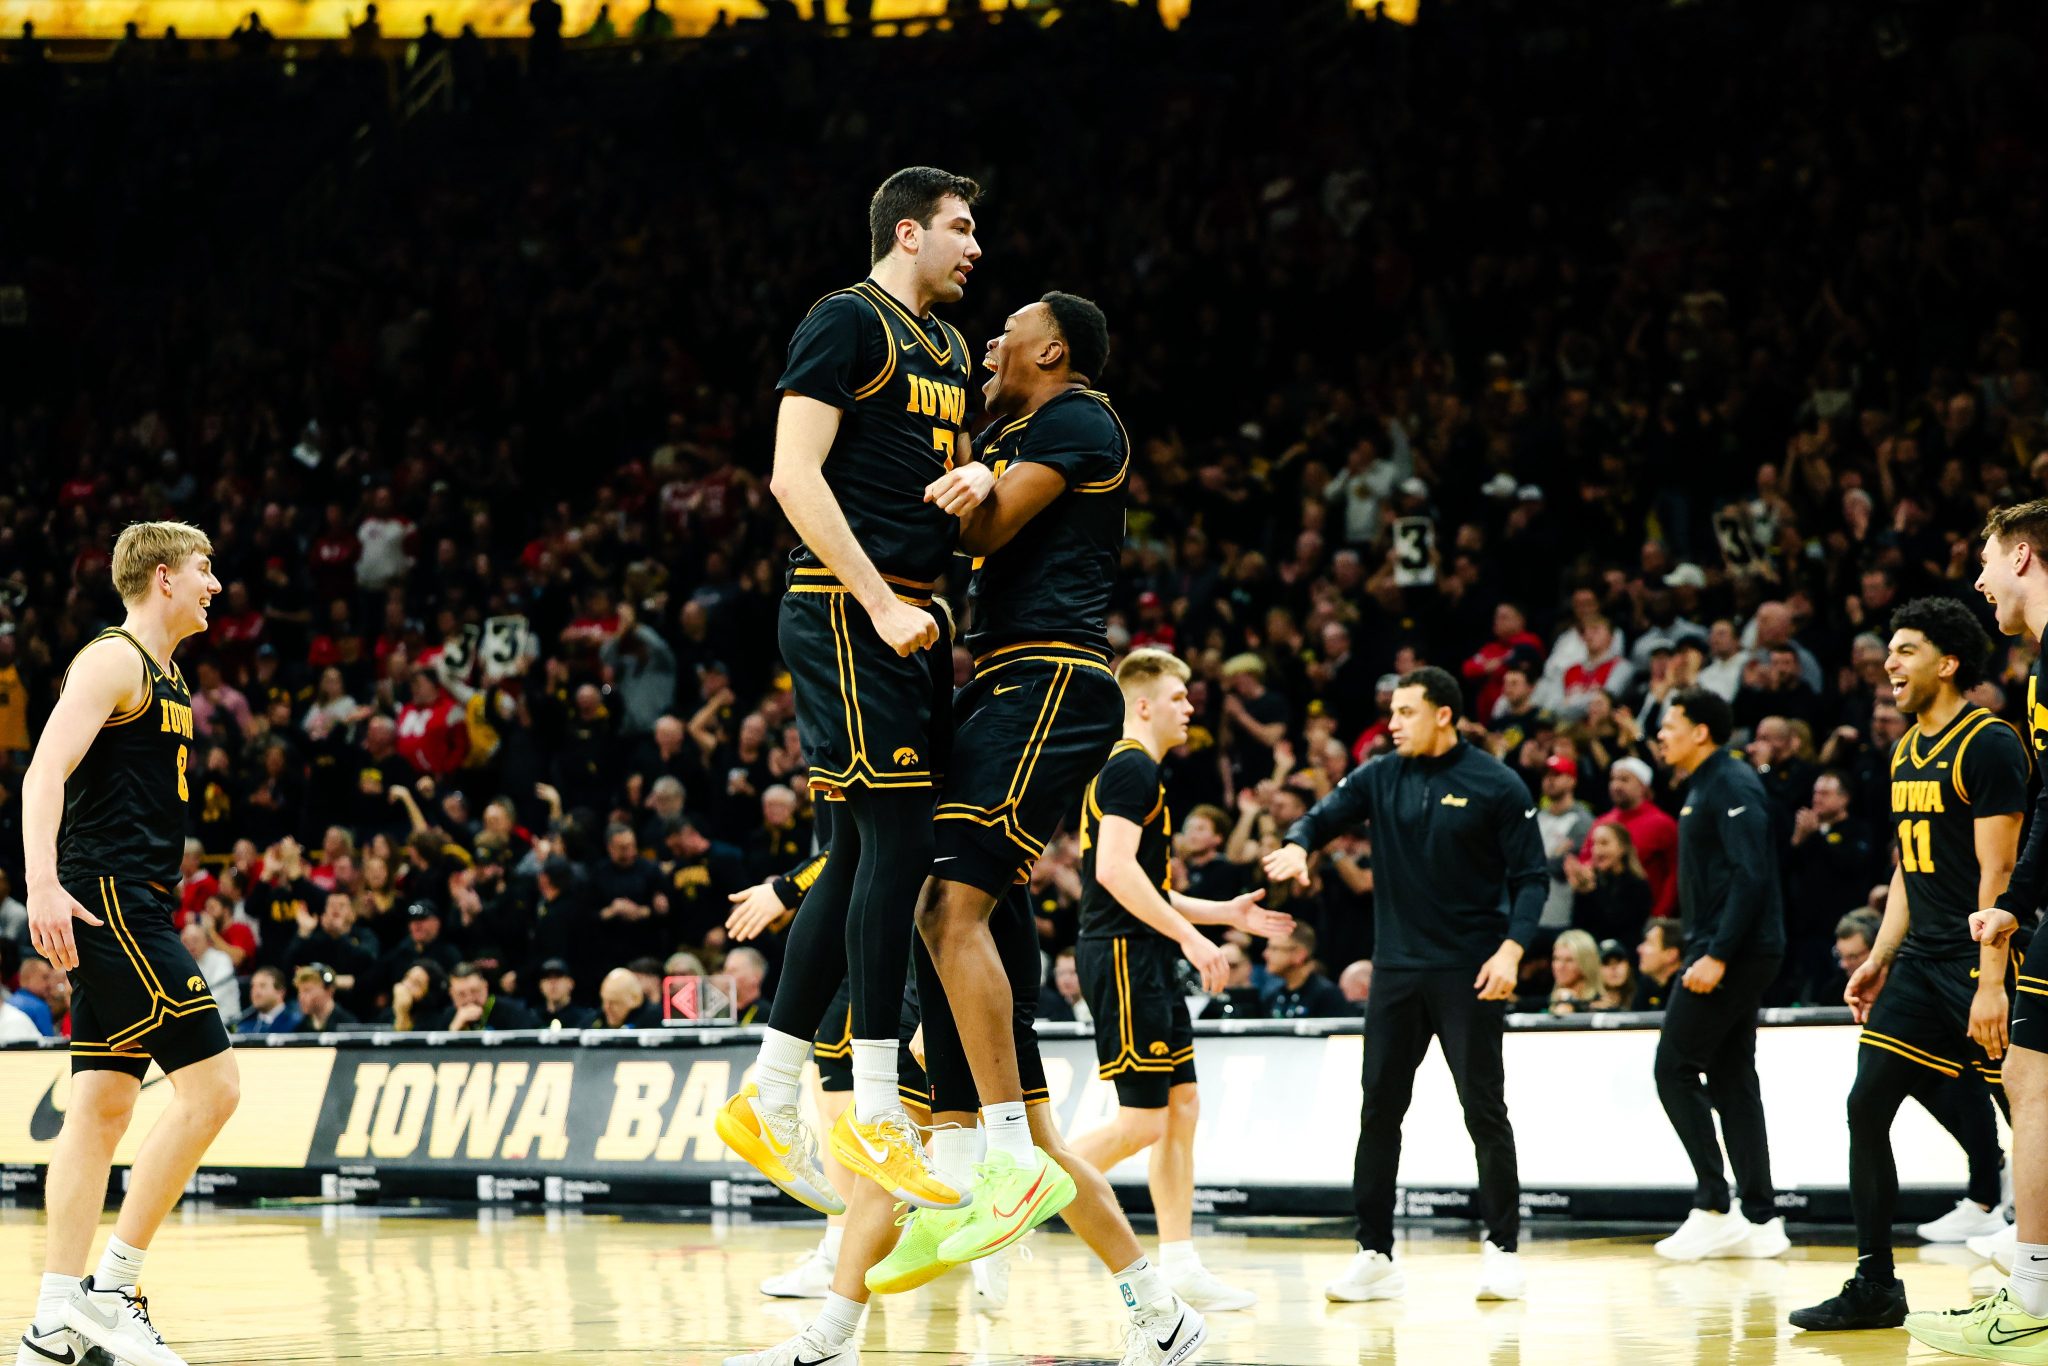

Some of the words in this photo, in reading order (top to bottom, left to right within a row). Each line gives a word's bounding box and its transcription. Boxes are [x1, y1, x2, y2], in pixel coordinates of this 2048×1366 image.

[933, 427, 954, 474] 7
[1401, 524, 1429, 569] 3
[493, 625, 518, 662] 3
[160, 699, 193, 740] IOW
[177, 744, 189, 803] 8
[1891, 781, 1945, 813] IOWA
[1898, 819, 1935, 873] 11
[335, 1061, 573, 1161] IOWA
